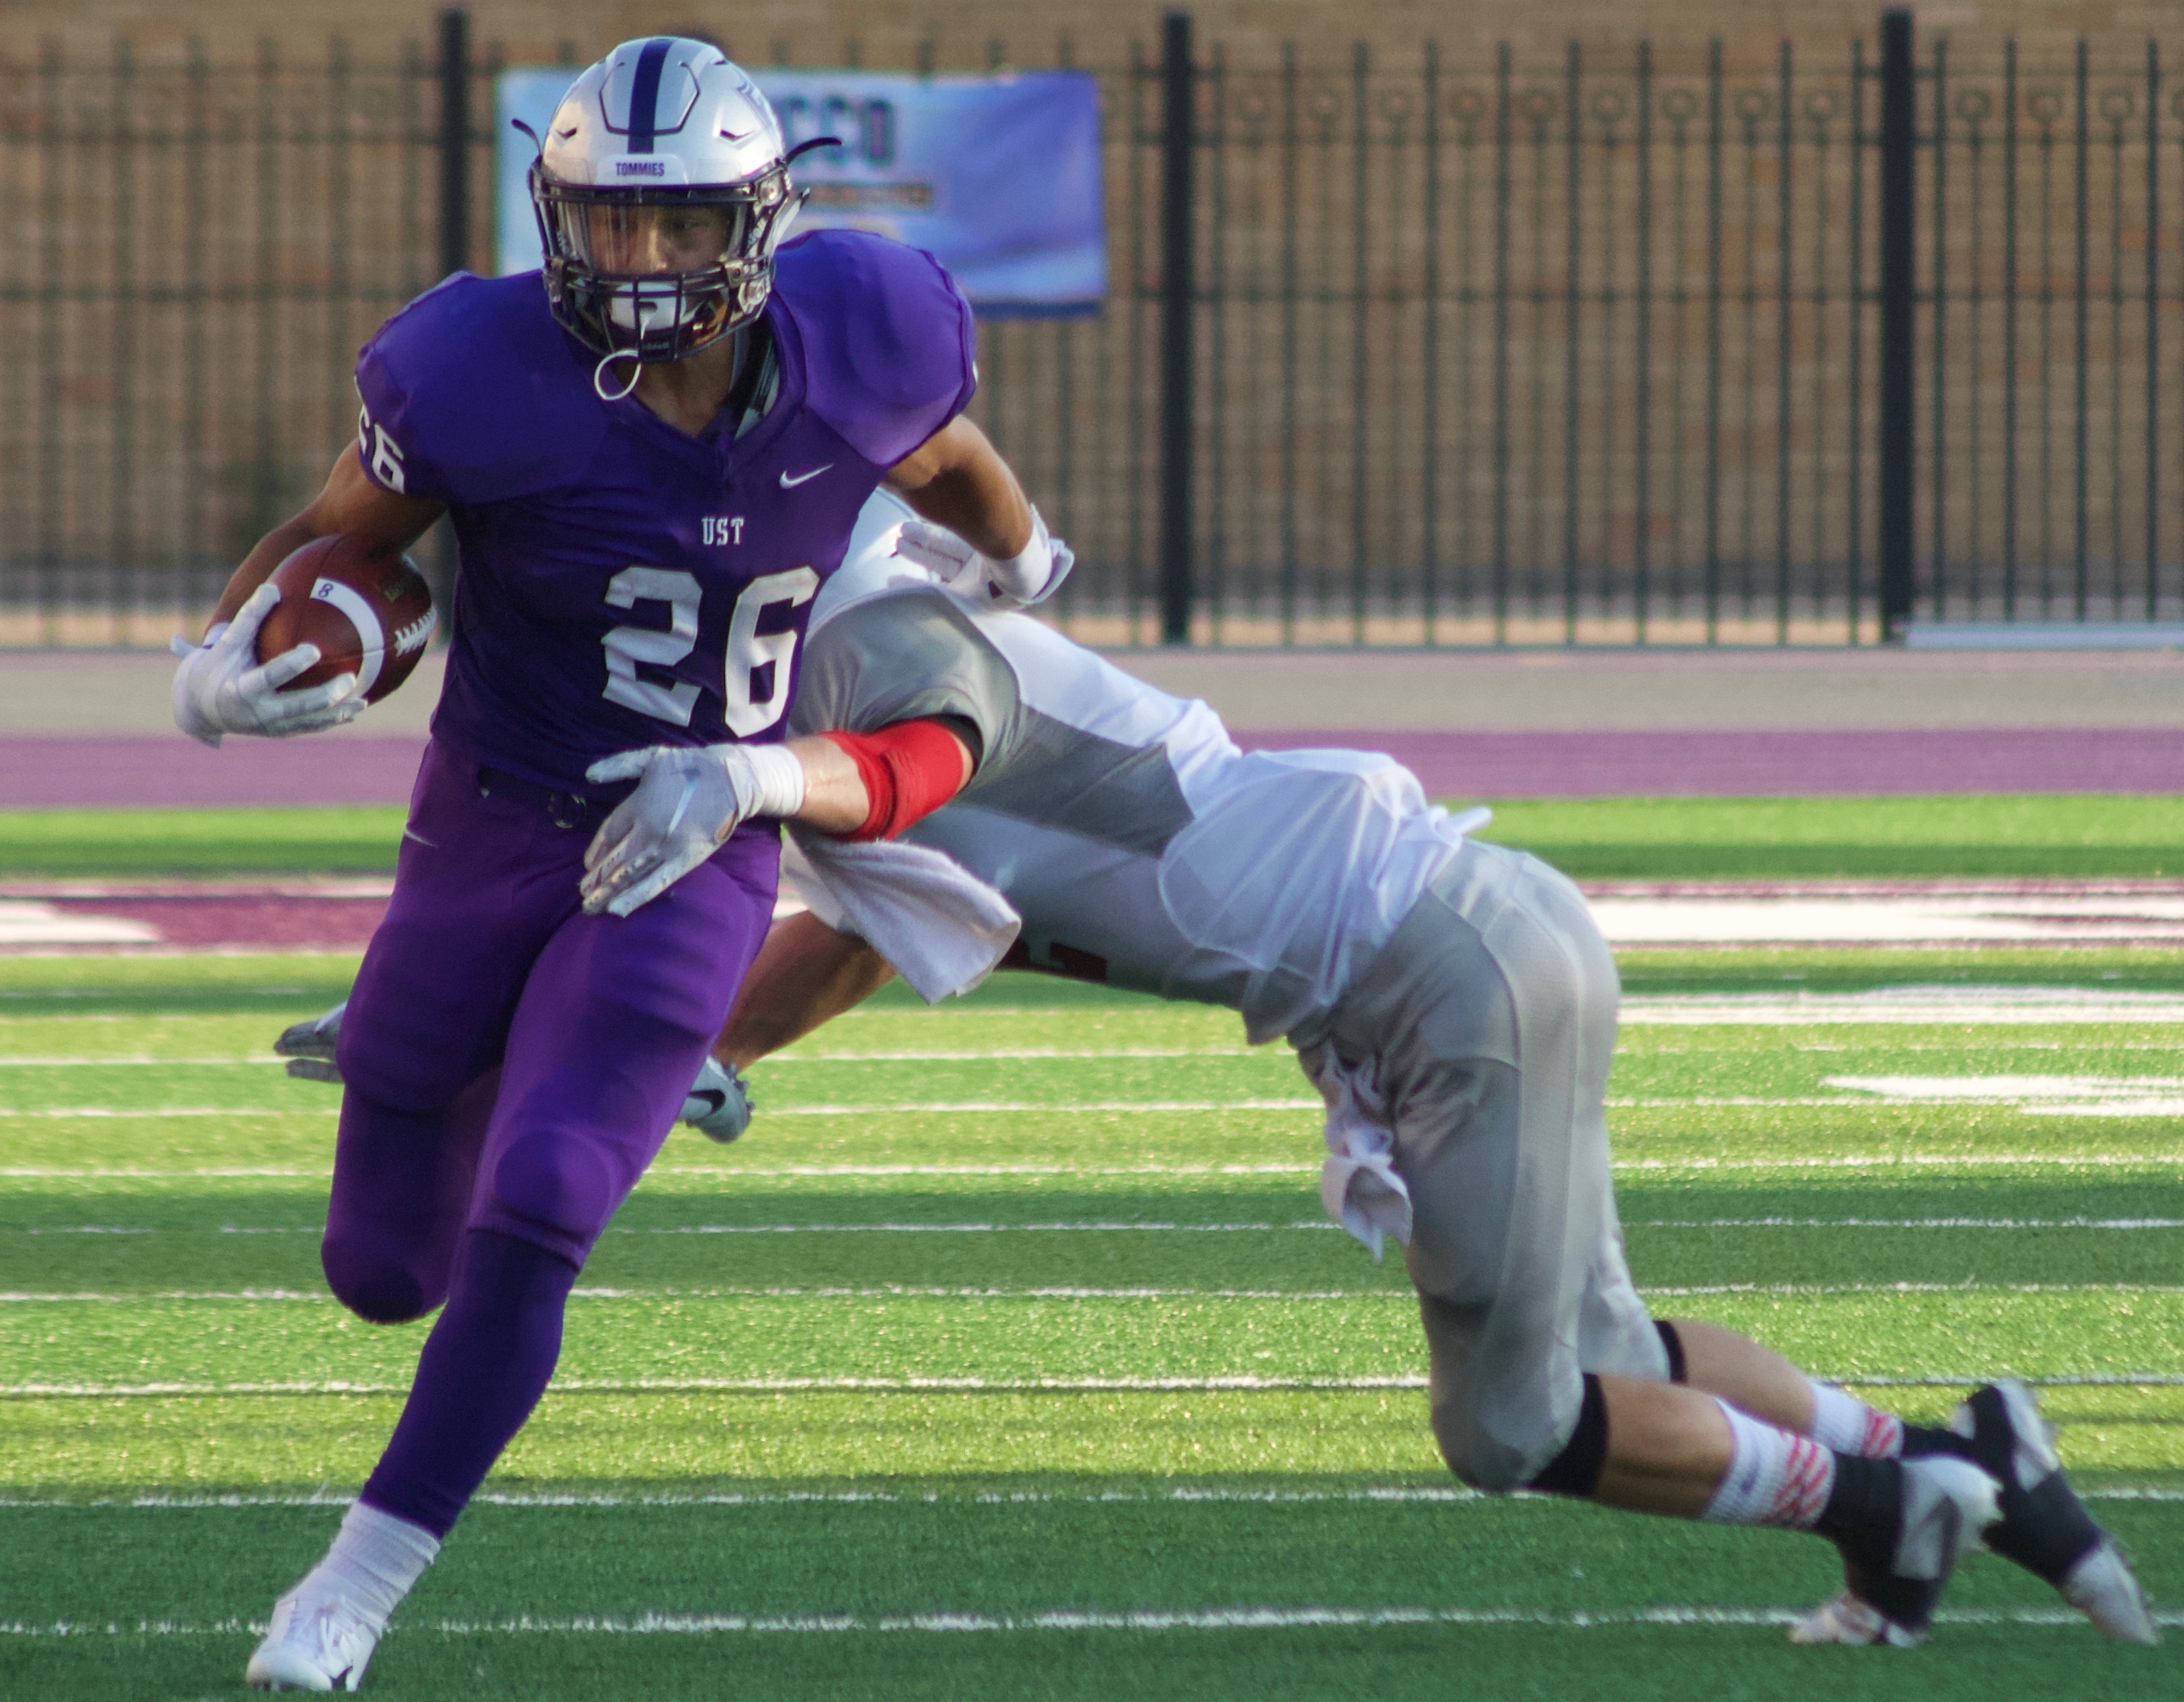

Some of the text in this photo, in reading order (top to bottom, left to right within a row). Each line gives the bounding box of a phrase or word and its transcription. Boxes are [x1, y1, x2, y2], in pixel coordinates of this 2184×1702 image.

[616, 162, 665, 177] TOMMIES
[701, 516, 744, 547] UST
[317, 583, 334, 598] 8
[601, 564, 821, 739] 26
